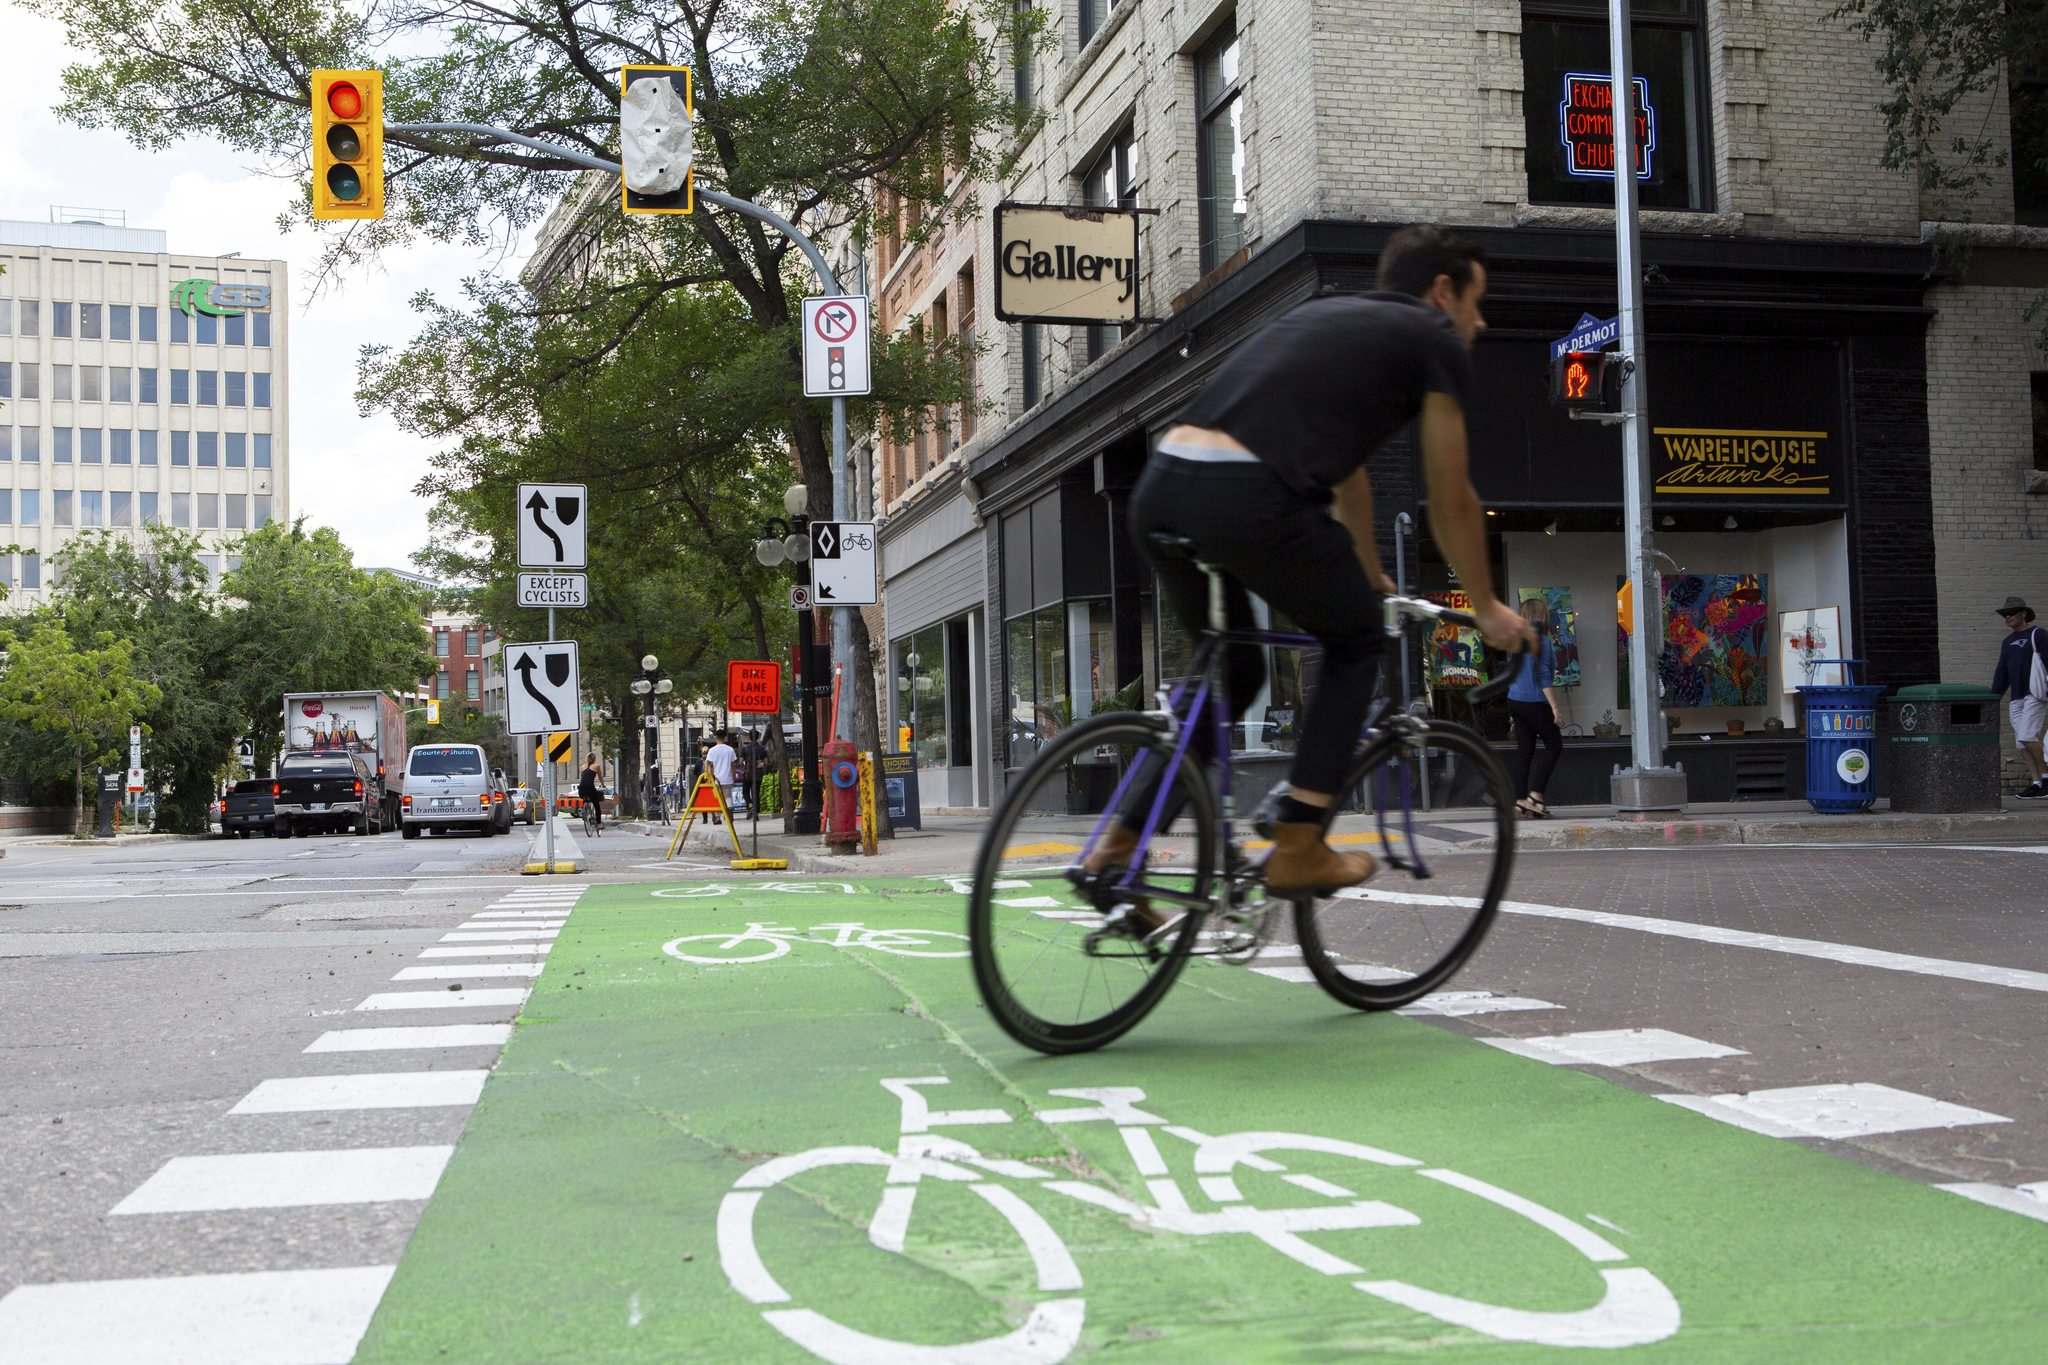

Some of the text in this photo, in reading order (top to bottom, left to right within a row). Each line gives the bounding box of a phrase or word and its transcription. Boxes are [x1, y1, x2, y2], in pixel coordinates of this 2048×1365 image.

[1574, 84, 1639, 110] EXCHAE
[1569, 113, 1646, 137] COMMUTY
[1002, 239, 1134, 303] Gallery
[211, 284, 271, 308] G3
[1664, 437, 1816, 464] WAREHOUSE
[530, 577, 574, 589] EXCEPT
[525, 590, 580, 602] CYCLISTS
[742, 668, 767, 680] BIKE
[740, 682, 768, 693] LANE
[734, 695, 774, 706] CLOSED
[416, 806, 477, 814] frankmotors.ca
